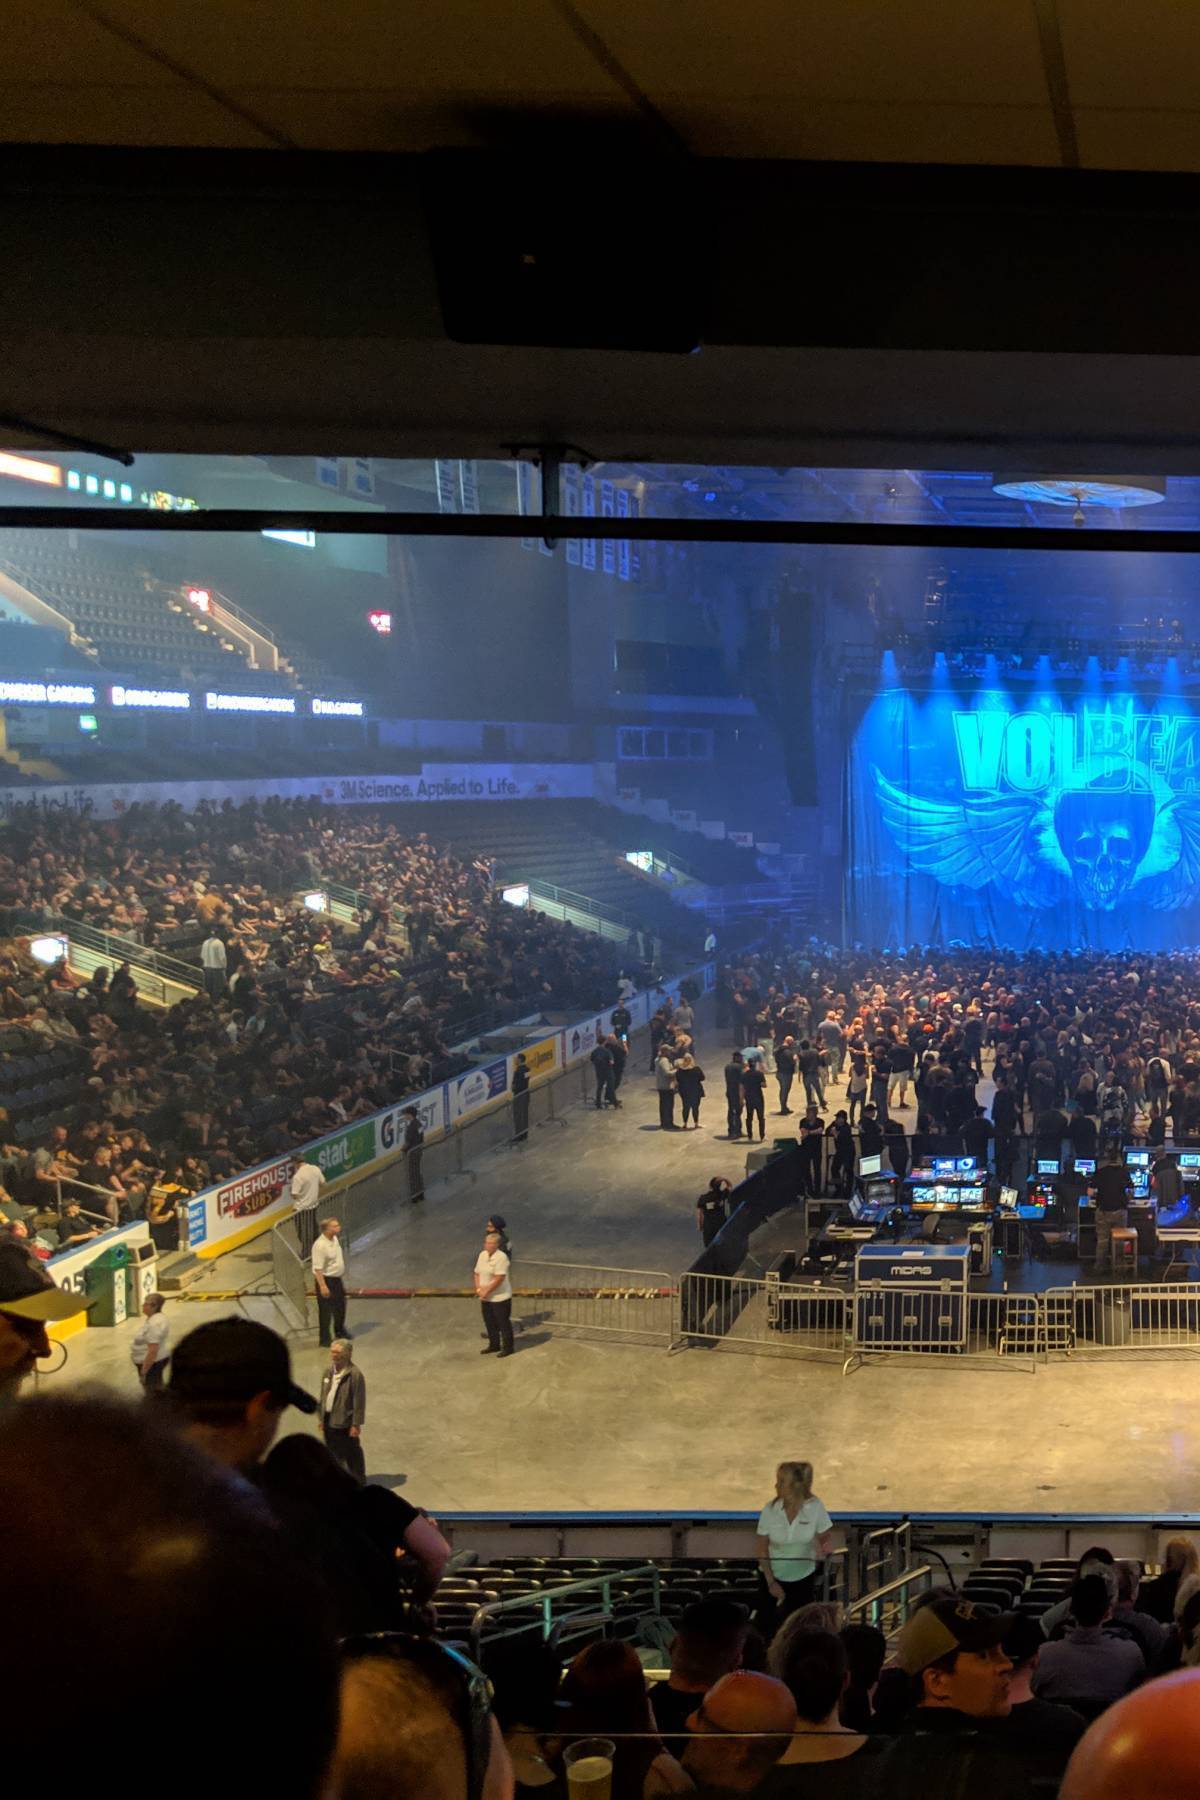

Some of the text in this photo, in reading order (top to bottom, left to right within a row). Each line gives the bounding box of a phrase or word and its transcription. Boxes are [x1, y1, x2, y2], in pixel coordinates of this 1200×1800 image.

[340, 778, 520, 800] 3M Science. Applied to Life.
[218, 1164, 294, 1217] FIREHOUSE
[244, 1189, 273, 1212] SUBS
[890, 1265, 933, 1276] MIDAS
